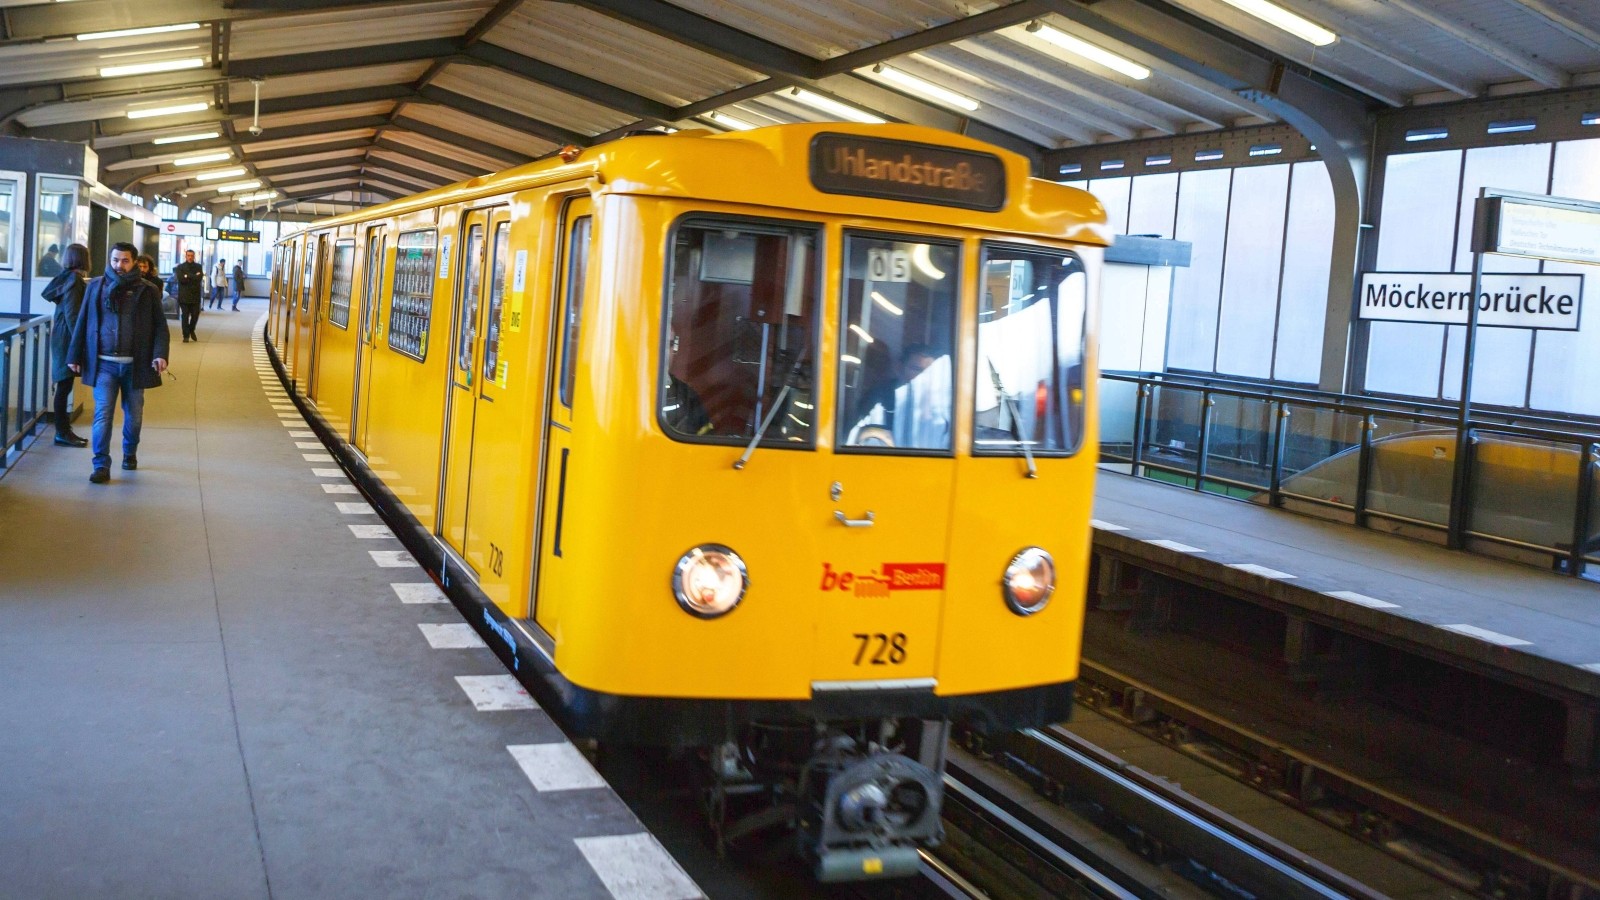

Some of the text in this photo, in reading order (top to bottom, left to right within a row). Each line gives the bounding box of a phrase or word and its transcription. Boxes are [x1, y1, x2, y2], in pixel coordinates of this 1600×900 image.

[873, 256, 905, 278] 05
[489, 543, 504, 578] 728
[853, 632, 907, 666] 728
